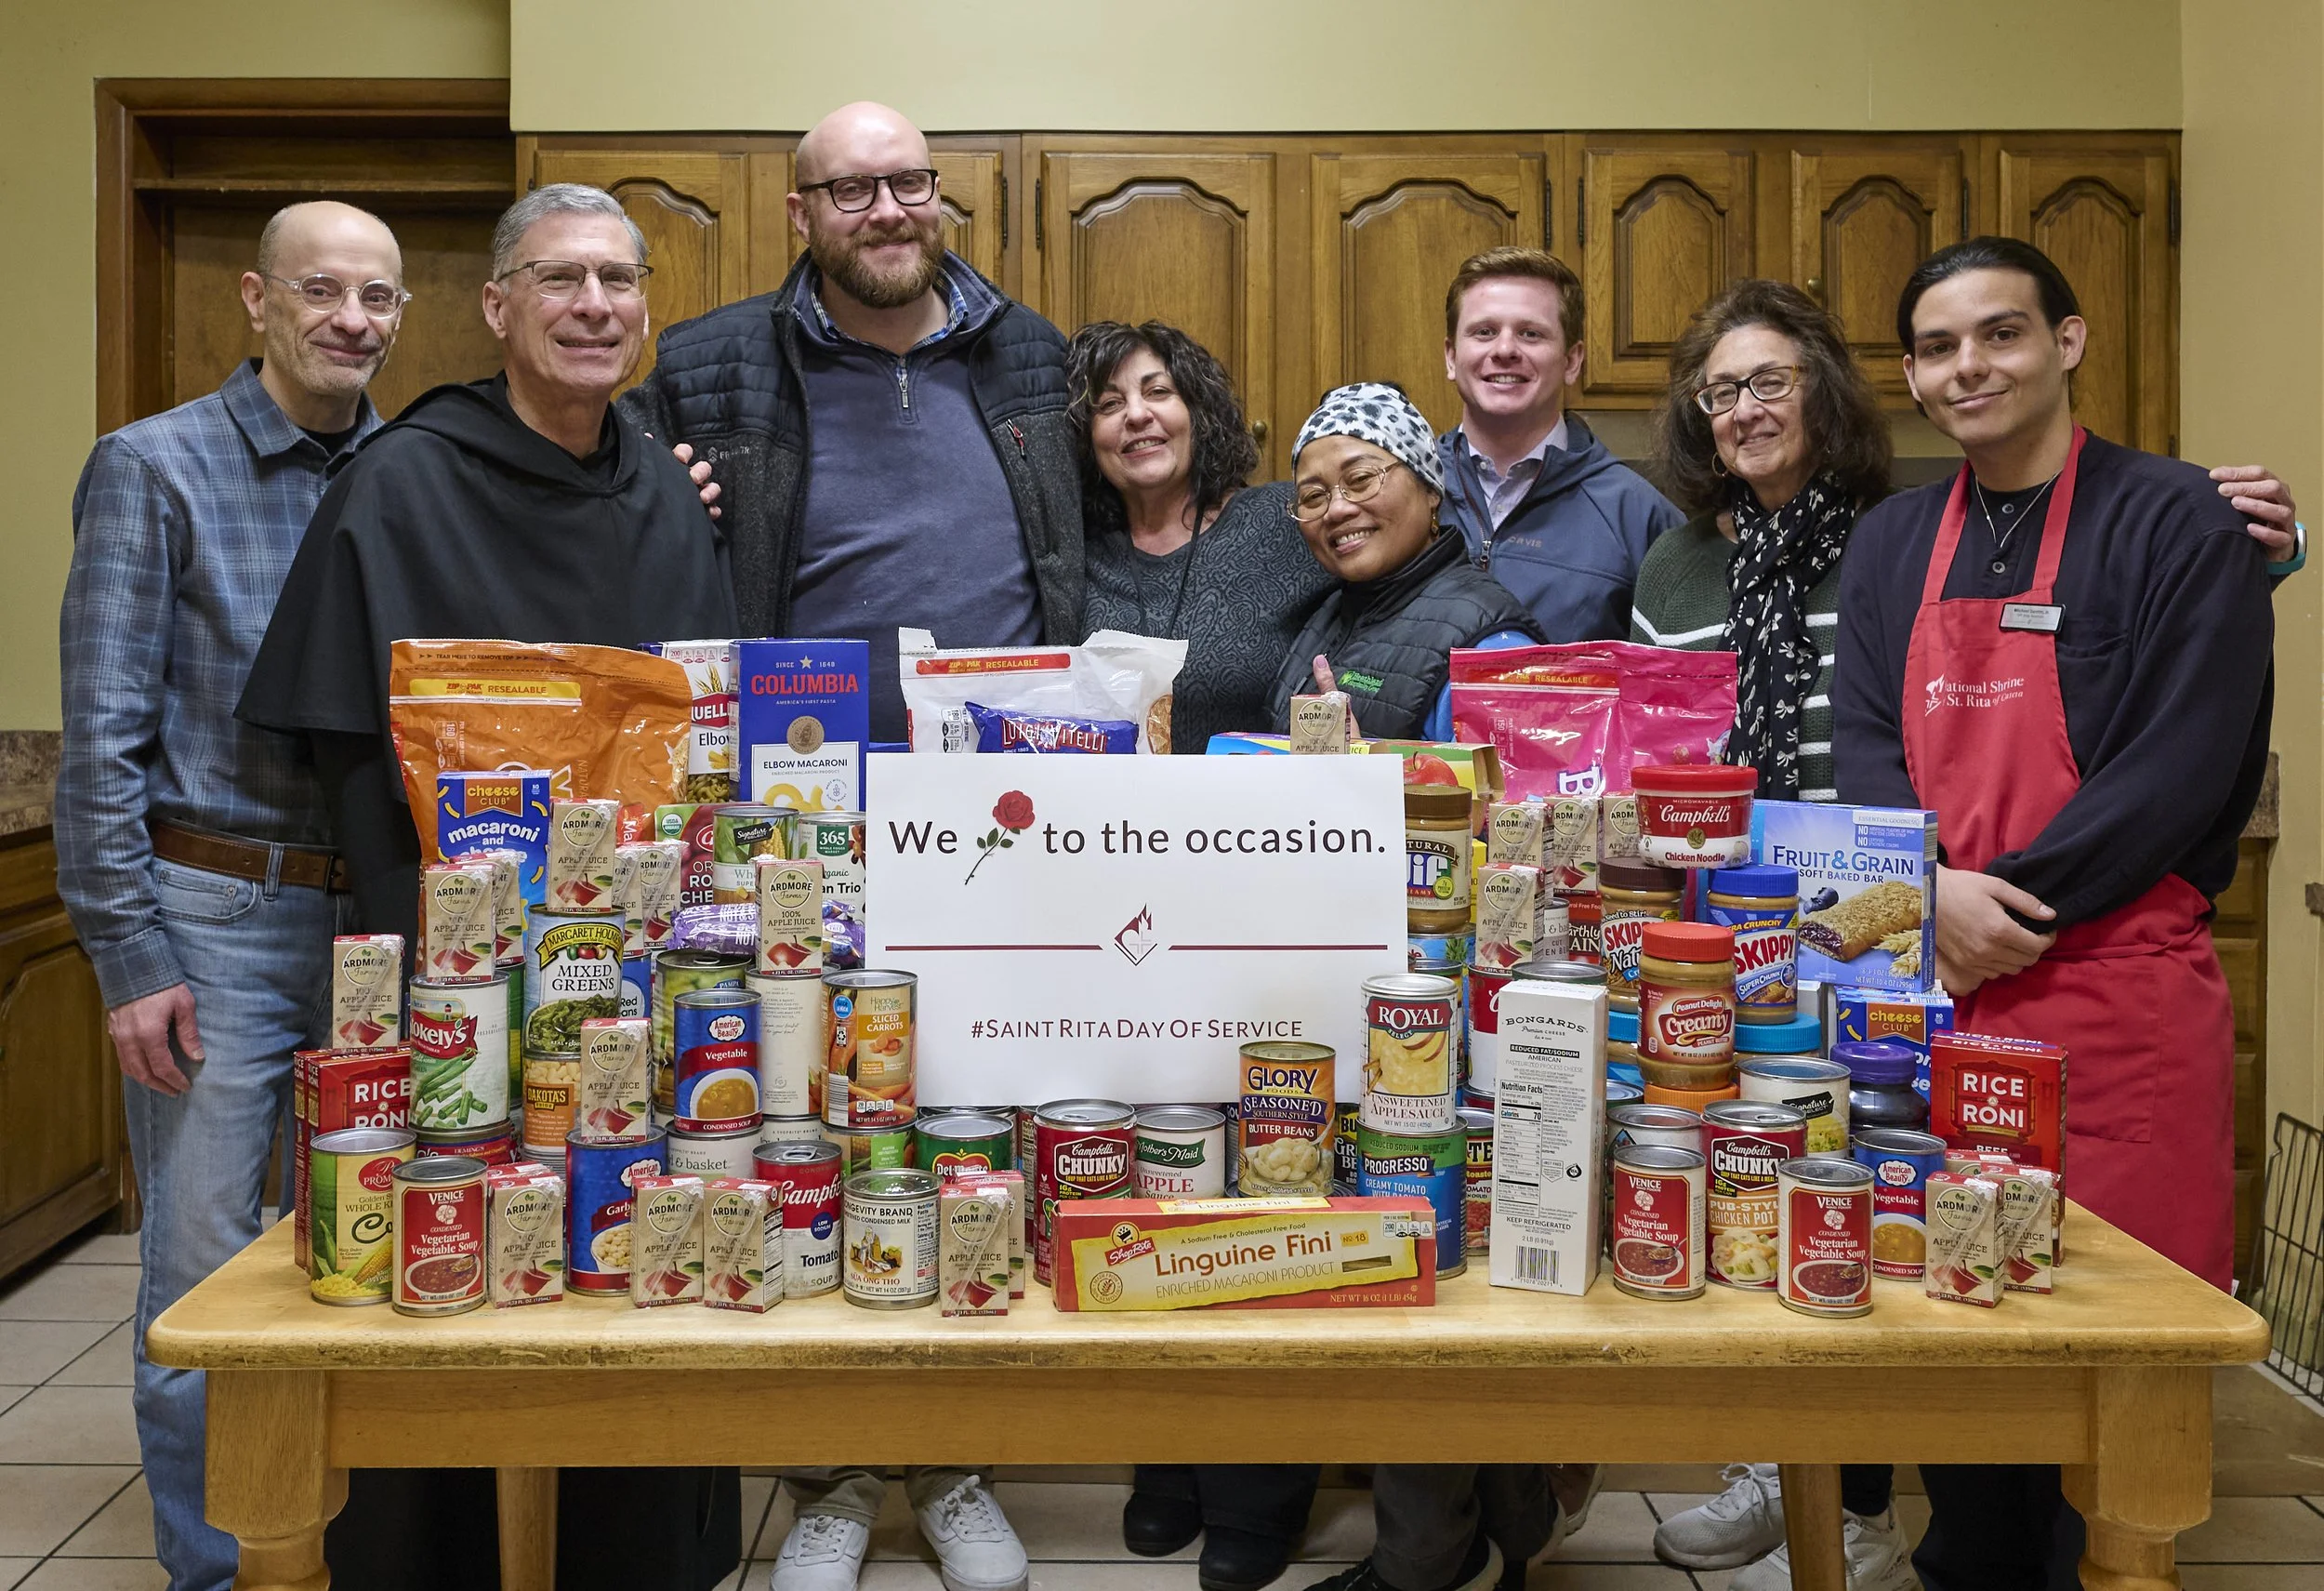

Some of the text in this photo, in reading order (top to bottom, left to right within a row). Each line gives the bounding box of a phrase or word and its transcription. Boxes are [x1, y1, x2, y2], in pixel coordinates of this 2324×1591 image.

[1508, 536, 1543, 548] ORVIS
[985, 658, 1039, 669] RESEALABLE
[750, 673, 859, 696] COLUMBIA
[1536, 675, 1588, 683] RESEALABLE
[1944, 677, 2025, 694] ational Shrine
[488, 685, 547, 694] RESEALABLE
[1947, 694, 1963, 707] St.
[1966, 695, 1991, 708] Rita
[763, 758, 848, 770] ELBOW MACARONI
[467, 785, 520, 797] cheese
[480, 797, 508, 806] CLUB
[1659, 805, 1731, 825] Campbell's
[447, 822, 541, 843] macaroni
[819, 831, 846, 844] 365
[889, 819, 1386, 855] We to the occasion.
[1858, 826, 1868, 836] NO
[482, 835, 504, 845] and
[1858, 837, 1868, 847] NO
[1665, 852, 1725, 863] Chicken Noodle
[823, 869, 850, 881] rganic
[1800, 869, 1884, 883] SOFT BAKED BAR
[770, 882, 813, 893] ARDMORE
[836, 882, 861, 894] Trio
[768, 918, 816, 927] APPLE JUICE
[1743, 920, 1782, 930] CRUNCHY
[548, 927, 594, 947] MARGARET
[1734, 935, 1795, 974] SKIPPY
[343, 958, 389, 968] ARDMORE
[558, 964, 612, 977] MIXED
[552, 977, 614, 991] GREENS
[1676, 999, 1723, 1012] Peanut Delight
[872, 1014, 899, 1024] SLICED
[1379, 1006, 1444, 1030] ROYAL
[1869, 1009, 1922, 1024] cheese
[714, 1020, 742, 1030] American
[866, 1022, 904, 1032] CARROTS
[1505, 1016, 1586, 1033] BONGARDS
[1665, 1014, 1729, 1036] Creamy
[1882, 1023, 1910, 1032] CLUB
[717, 1029, 740, 1040] Beauty
[1388, 1028, 1413, 1040] SELECT
[706, 1049, 747, 1063] Vegetable
[1511, 1045, 1578, 1057] REDUCED FAT/SODIUM
[1527, 1054, 1562, 1063] AMERICAN
[1248, 1067, 1318, 1094] GLORY
[1963, 1072, 2024, 1097] RICE
[355, 1079, 410, 1103] RICE
[1501, 1081, 1543, 1094] Nutrition Facts
[525, 1088, 566, 1103] DAKOTA'S
[1372, 1094, 1446, 1107] UNSWEETENED
[1243, 1095, 1322, 1116] SEASONED
[1371, 1104, 1446, 1119] APPLESAUCE
[1253, 1110, 1309, 1120] SOUTHERN STYLE
[1534, 1112, 1541, 1120] 70
[1963, 1103, 2024, 1128] RONI
[703, 1120, 751, 1131] CONDENSED SOUP
[1248, 1124, 1314, 1137] BUTTER BEANS
[1072, 1143, 1114, 1156] Campbell's
[1395, 1143, 1419, 1152] SODIUM
[1726, 1142, 1772, 1156] Campbell's
[1163, 1147, 1198, 1162] Maid
[675, 1155, 728, 1171] & basket
[937, 1163, 954, 1174] Del
[1058, 1154, 1125, 1175] CHUNKY
[1365, 1157, 1428, 1174] PROGRESSO
[1882, 1162, 1911, 1175] American
[627, 1164, 658, 1177] American
[1629, 1176, 1661, 1190] VENICE
[1885, 1173, 1909, 1185] Beauty
[1366, 1178, 1426, 1195] CREAMY TOMATO
[359, 1195, 384, 1204] Golden
[429, 1190, 464, 1205] VENICE
[1816, 1196, 1852, 1209] VENICE
[1874, 1193, 1919, 1207] Vegetable
[345, 1202, 380, 1213] WHOLE
[879, 1207, 913, 1217] BRAND
[1630, 1210, 1659, 1219] CONDENSED
[1710, 1211, 1774, 1225] CHICKEN POT
[1524, 1218, 1571, 1229] REFRIGERATED
[1624, 1213, 1669, 1231] Vegetarian
[430, 1225, 462, 1233] CONDENSED
[1187, 1236, 1211, 1244] Sodium
[1235, 1226, 1272, 1238] Cholesterol
[1273, 1225, 1287, 1233] Free
[1289, 1223, 1306, 1231] Food
[1618, 1222, 1679, 1242] Vegetable Soup
[421, 1231, 470, 1245] Vegetarian
[1808, 1236, 1858, 1250] Vegetarian
[411, 1240, 478, 1256] Vegetable Soup
[1109, 1240, 1154, 1266] ShopRite
[1155, 1231, 1332, 1277] Linguine Fini
[1799, 1244, 1866, 1260] Vegetable Soup
[800, 1249, 838, 1267] Tomato
[811, 1275, 833, 1286] SOUP
[1155, 1261, 1335, 1299] ENRICHED MACARONI PRODUCT
[1330, 1293, 1369, 1303] NET WT 16
